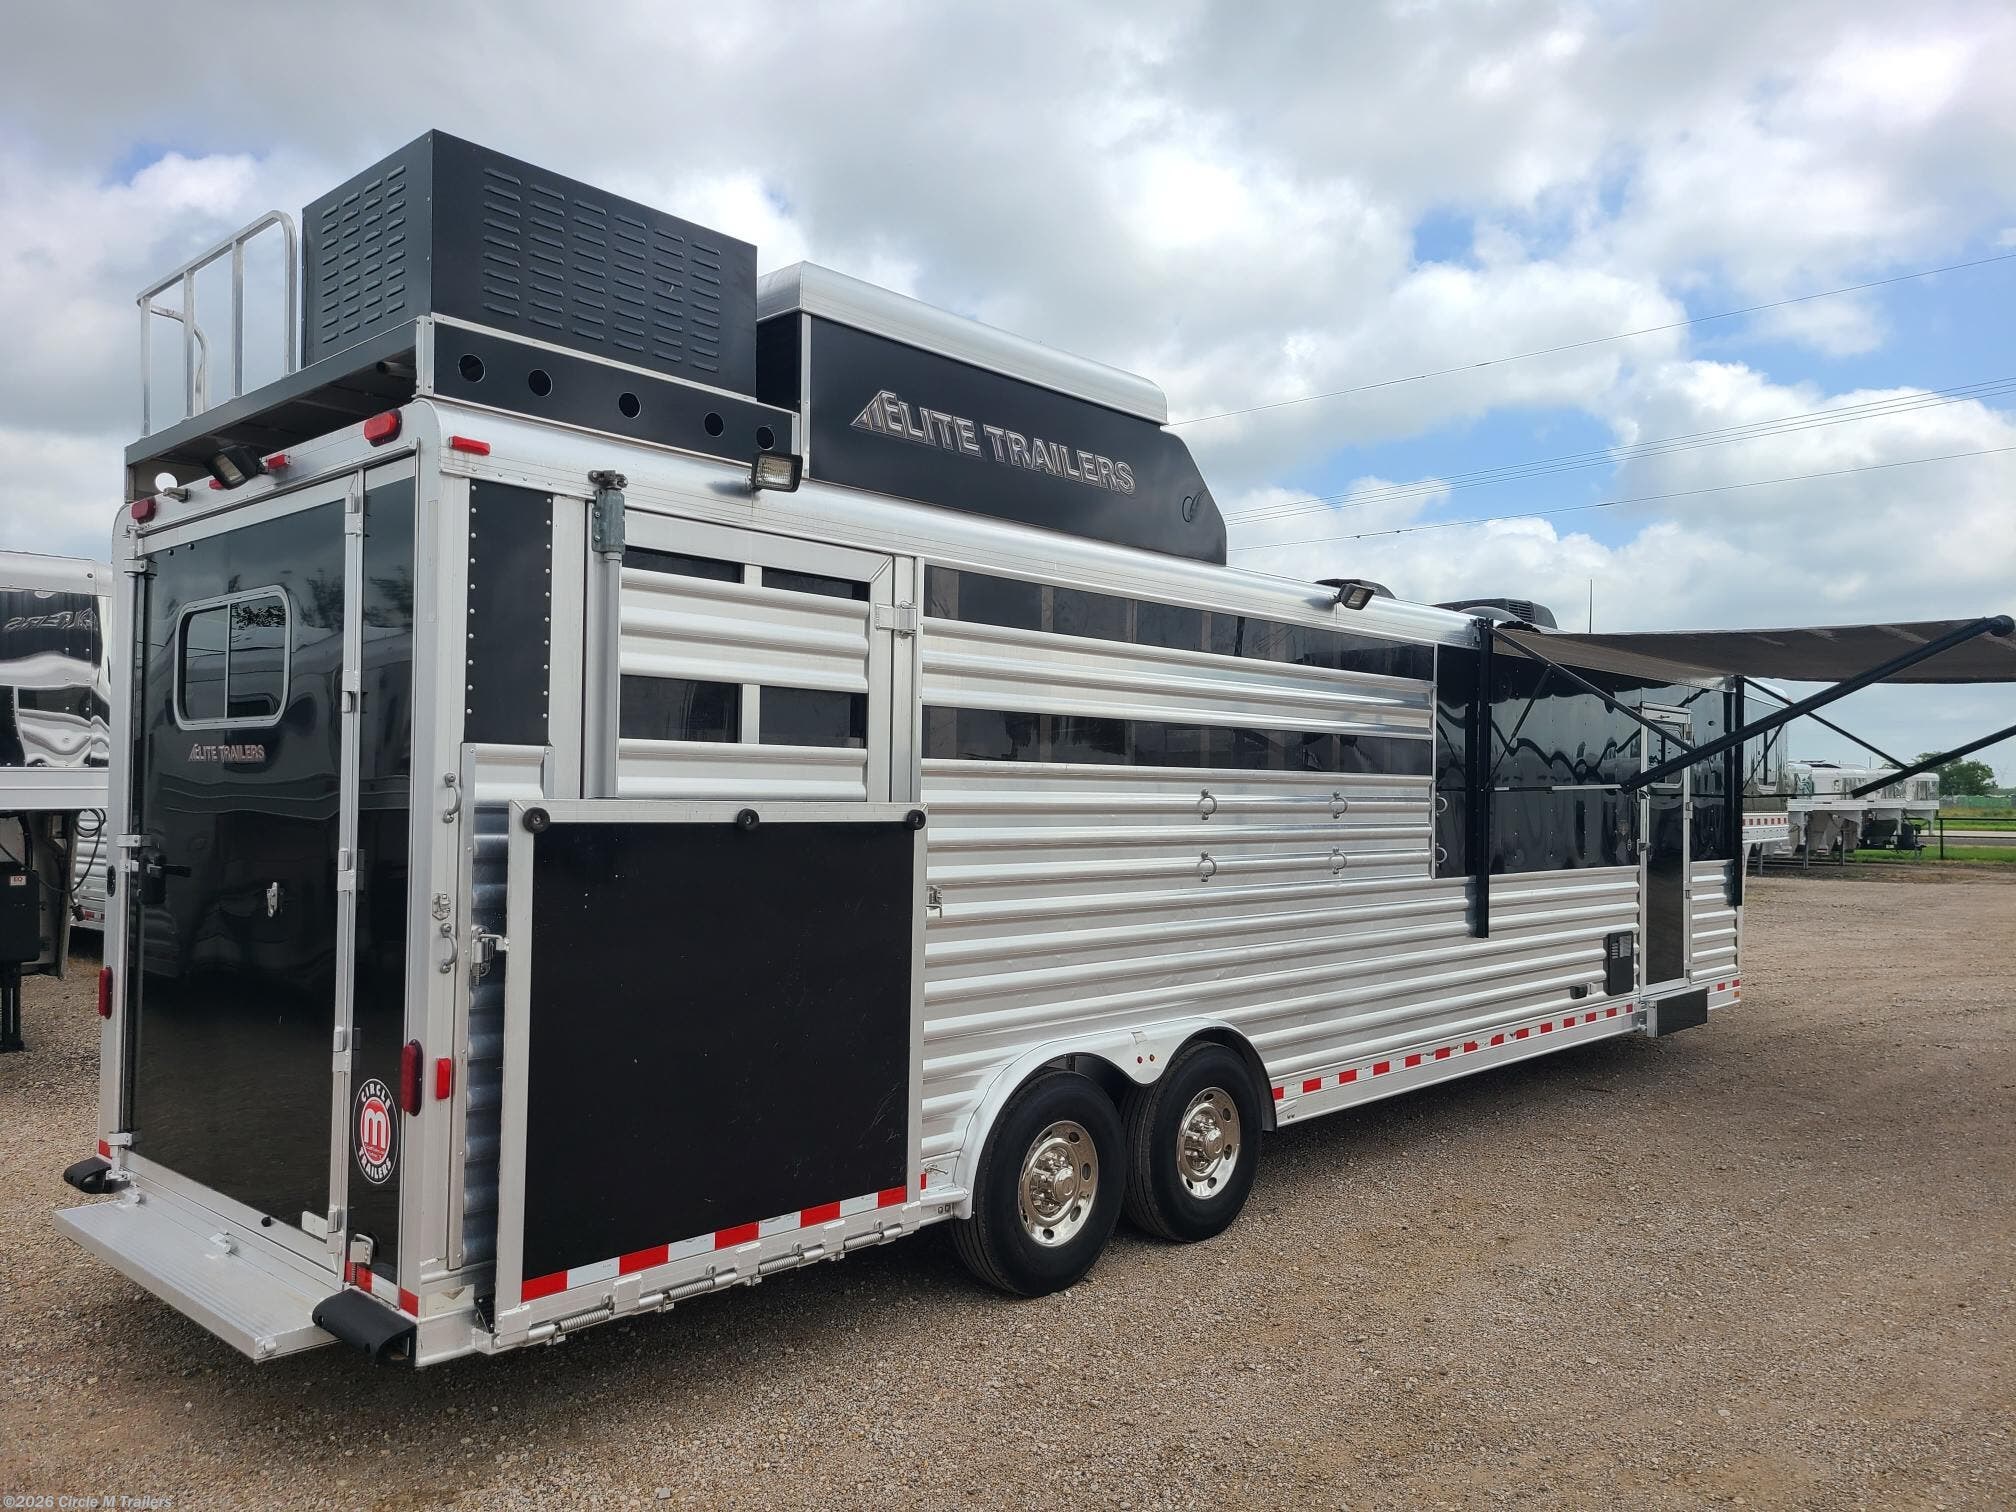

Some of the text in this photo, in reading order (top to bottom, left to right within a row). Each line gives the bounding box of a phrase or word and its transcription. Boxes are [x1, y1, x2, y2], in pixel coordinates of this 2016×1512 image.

[851, 390, 1136, 495] ELITE TRAILERS
[188, 743, 265, 762] ELITE TRAILERS
[361, 1083, 391, 1110] CIRCLE
[359, 1146, 391, 1179] TRAILERS
